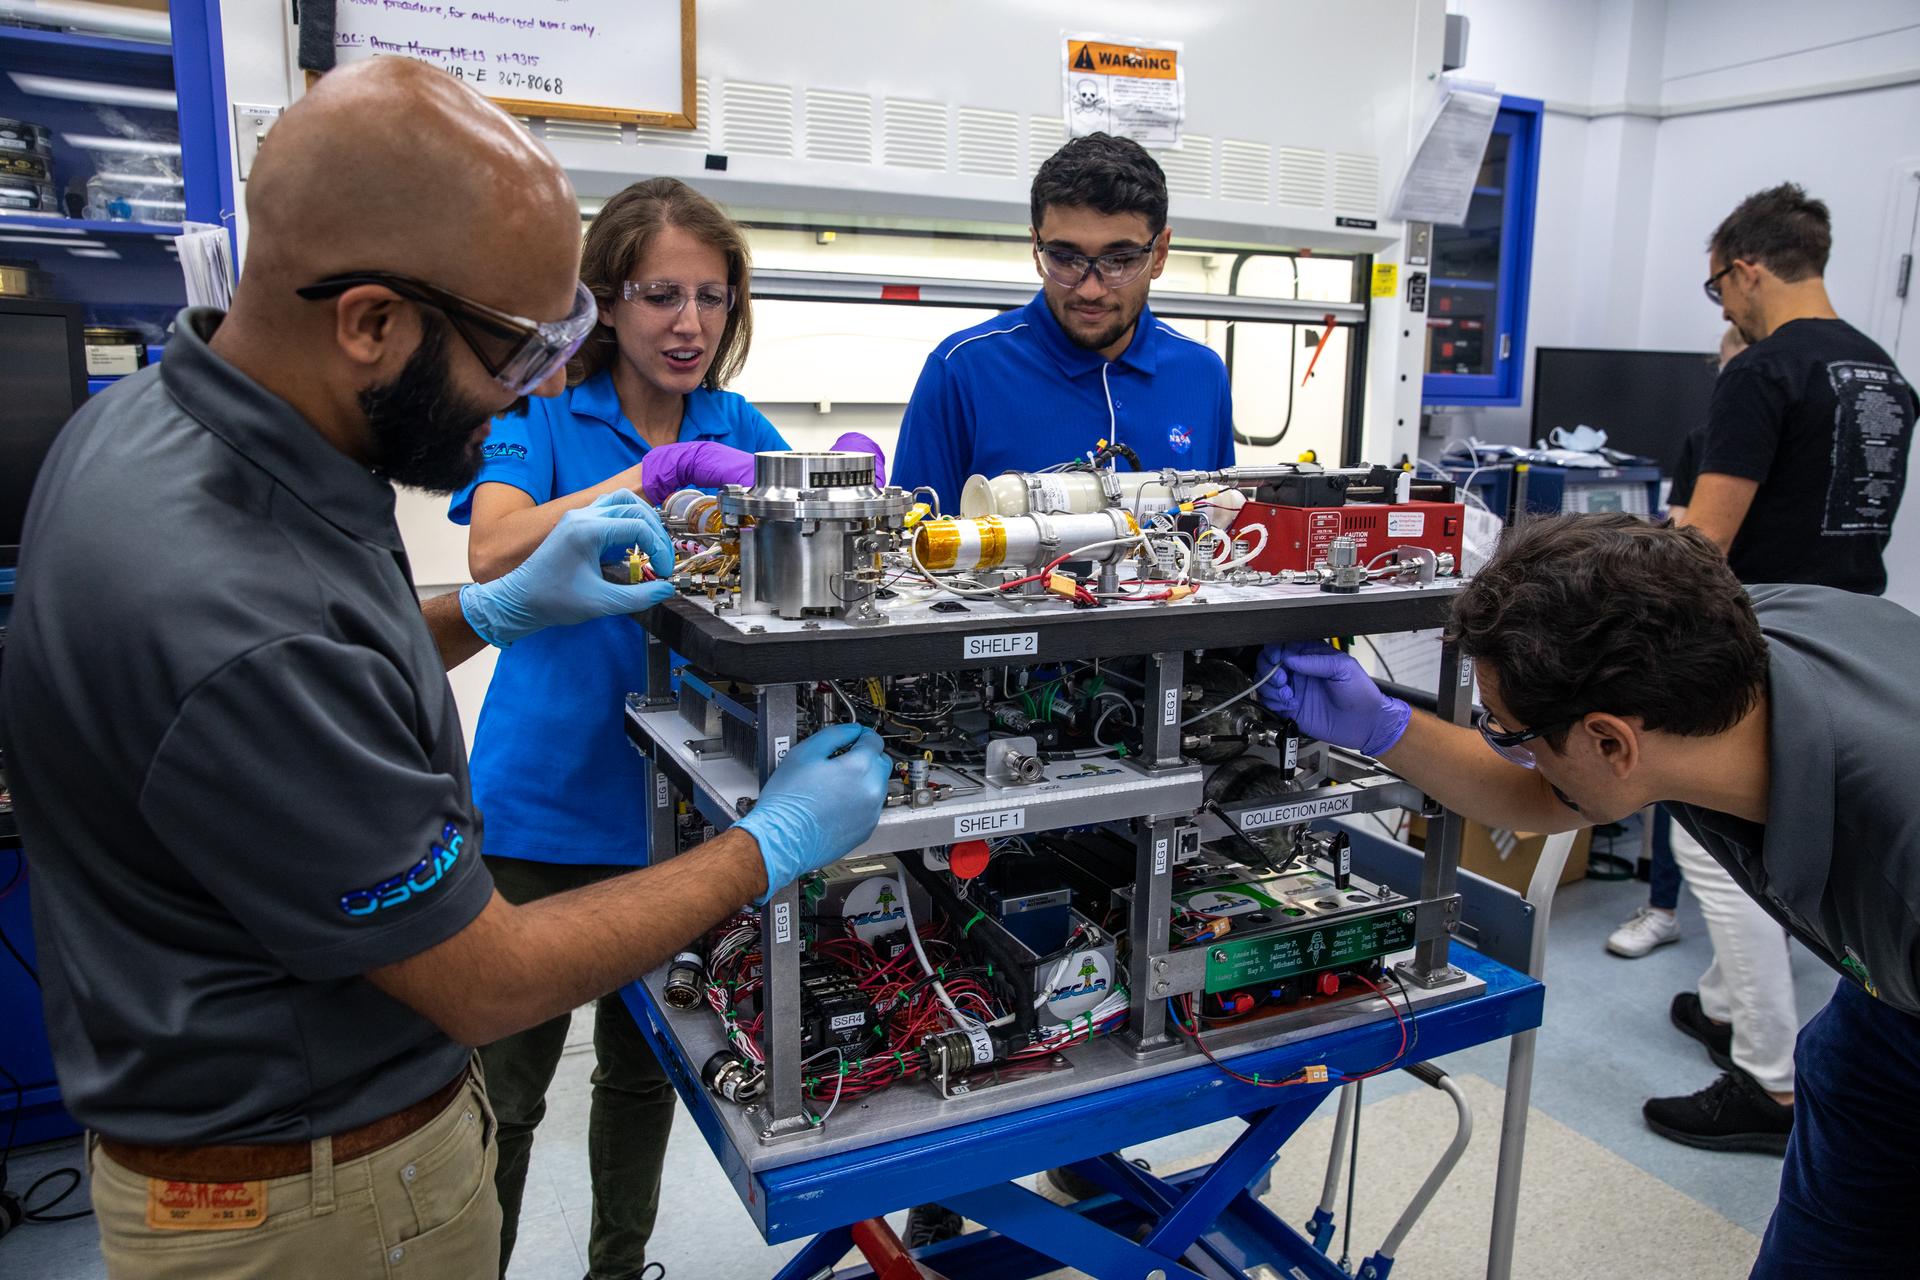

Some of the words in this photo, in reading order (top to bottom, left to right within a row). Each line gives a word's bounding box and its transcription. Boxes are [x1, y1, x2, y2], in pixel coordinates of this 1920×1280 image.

[1098, 52, 1171, 71] WARNING
[499, 71, 563, 95] 867-8068
[970, 637, 1021, 655] SHELF
[1025, 636, 1033, 651] 2
[1462, 664, 1470, 684] LEG
[1167, 691, 1176, 699] 2
[1166, 701, 1175, 723] LEG
[1287, 759, 1296, 767] 2
[658, 773, 667, 784] 10
[658, 786, 667, 807] LEG
[1245, 804, 1317, 826] COLLECTION
[1319, 798, 1349, 814] RACK
[960, 813, 1009, 833] SHELF
[1013, 812, 1019, 826] 1
[1157, 841, 1166, 849] 6
[339, 822, 464, 916] OSCAR
[1157, 852, 1165, 872] LEG
[777, 906, 788, 914] 5
[777, 915, 789, 939] LEG
[1049, 978, 1107, 1002] OSCAR
[833, 1014, 863, 1027] SSR4
[976, 1037, 990, 1061] CA1
